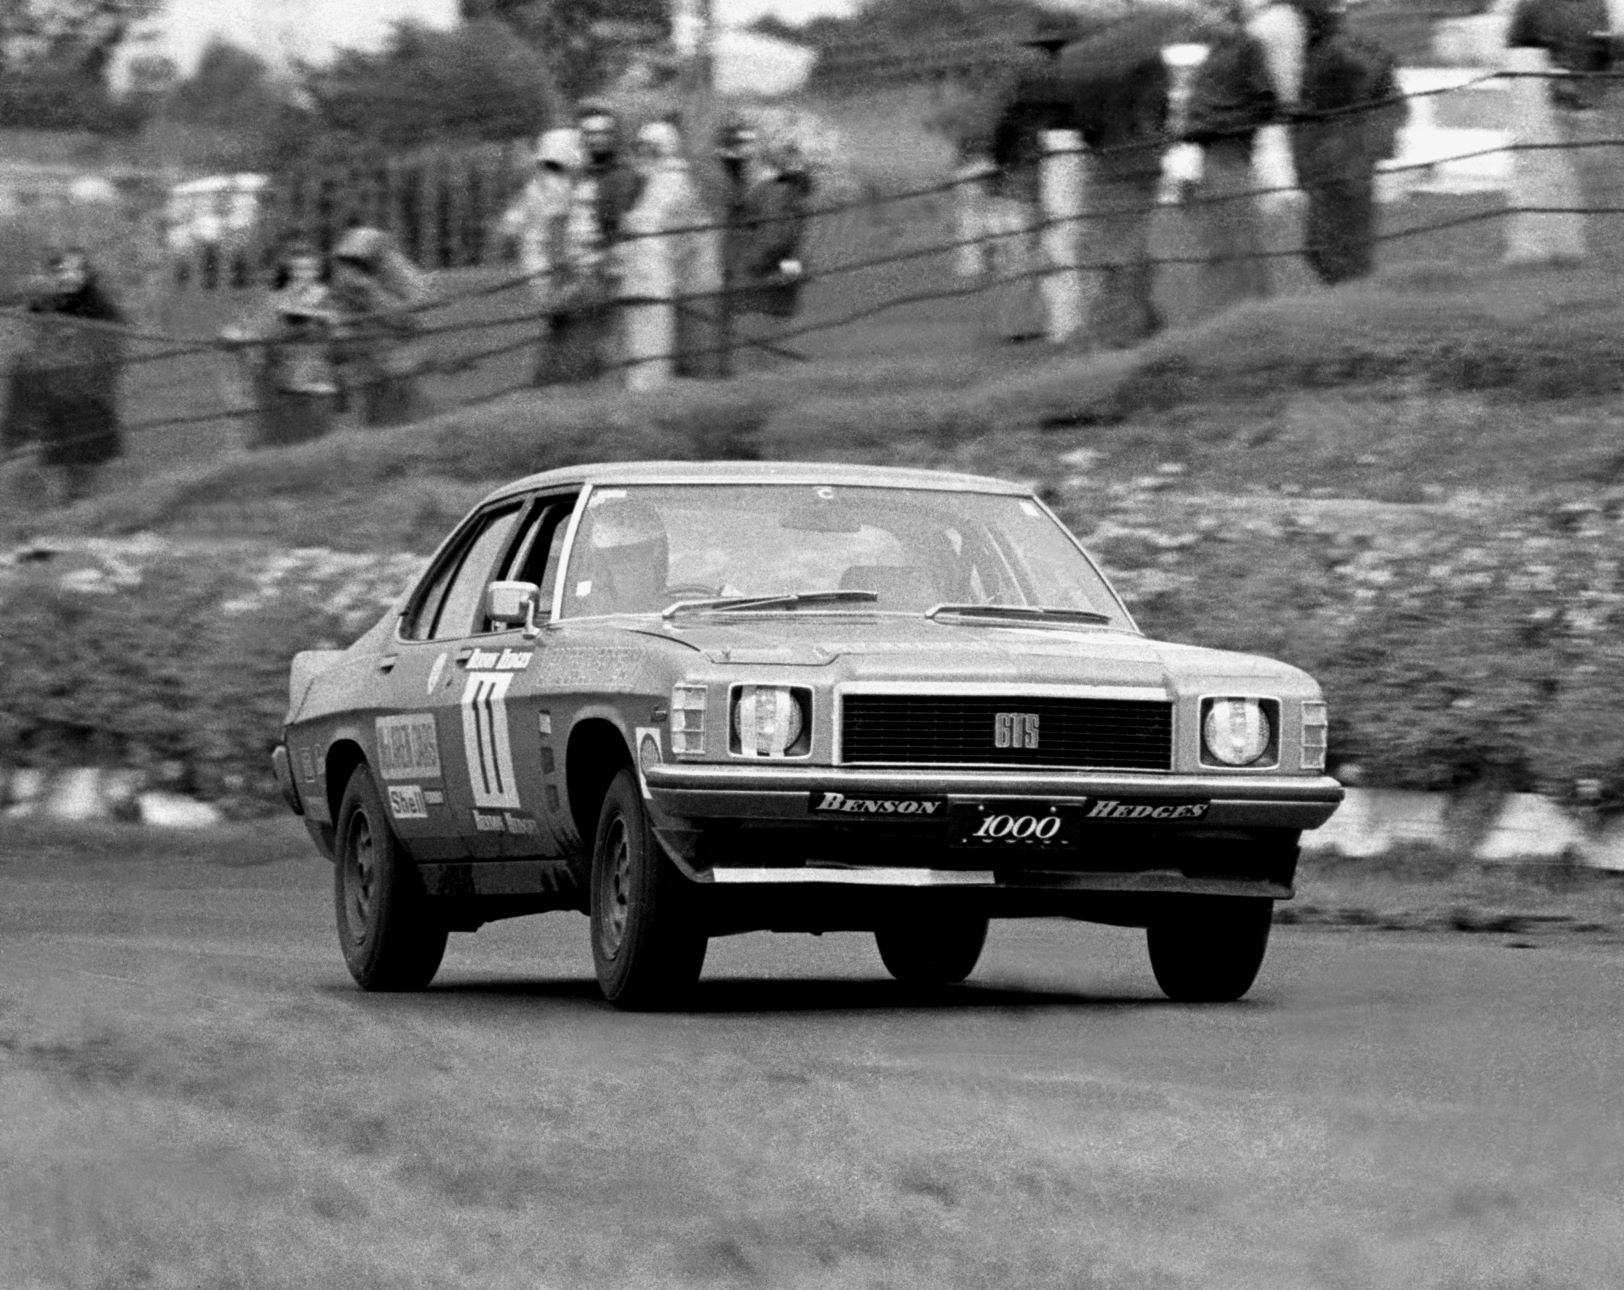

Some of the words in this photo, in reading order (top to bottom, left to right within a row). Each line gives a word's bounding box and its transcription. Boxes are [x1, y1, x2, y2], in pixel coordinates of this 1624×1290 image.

[995, 712, 1039, 748] GTS
[391, 790, 427, 814] Shell
[815, 792, 942, 814] BENSON
[1085, 800, 1209, 818] HEDGES
[972, 815, 1061, 839] 1000
